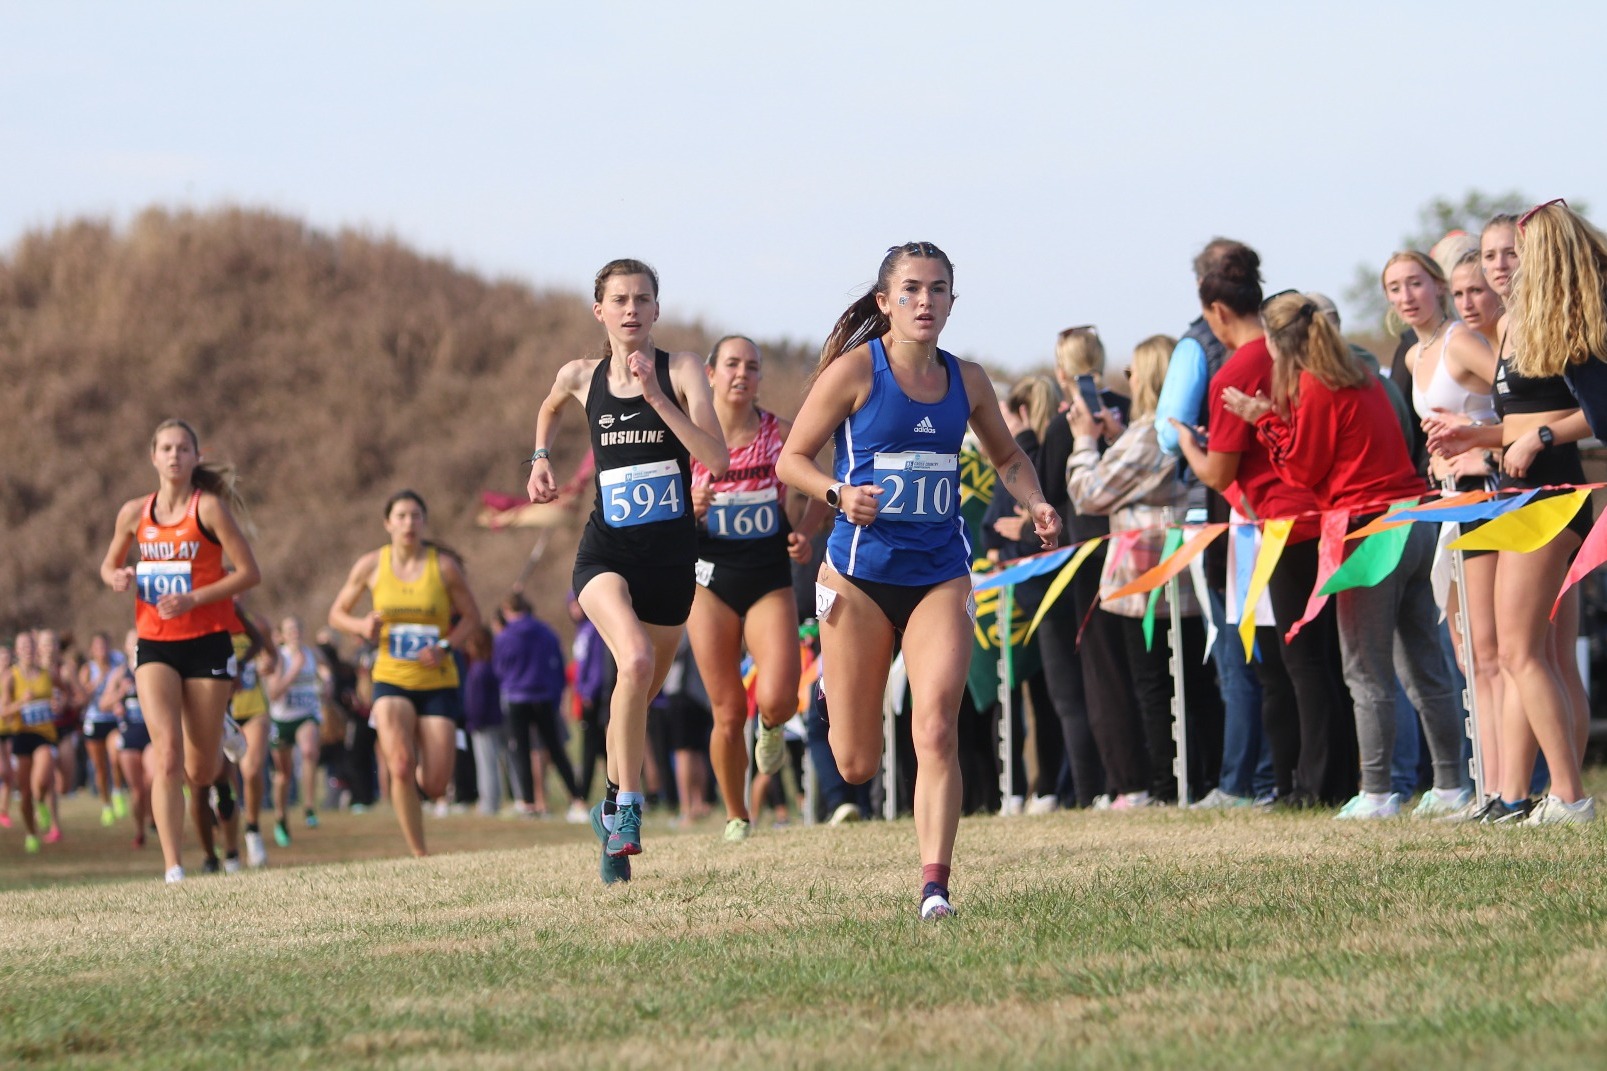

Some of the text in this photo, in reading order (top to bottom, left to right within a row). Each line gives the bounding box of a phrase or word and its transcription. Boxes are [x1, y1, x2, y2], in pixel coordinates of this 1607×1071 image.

[600, 430, 665, 447] URSULINE
[610, 479, 680, 522] 594
[879, 474, 951, 515] 210
[714, 505, 774, 536] 160
[142, 574, 188, 602] 190
